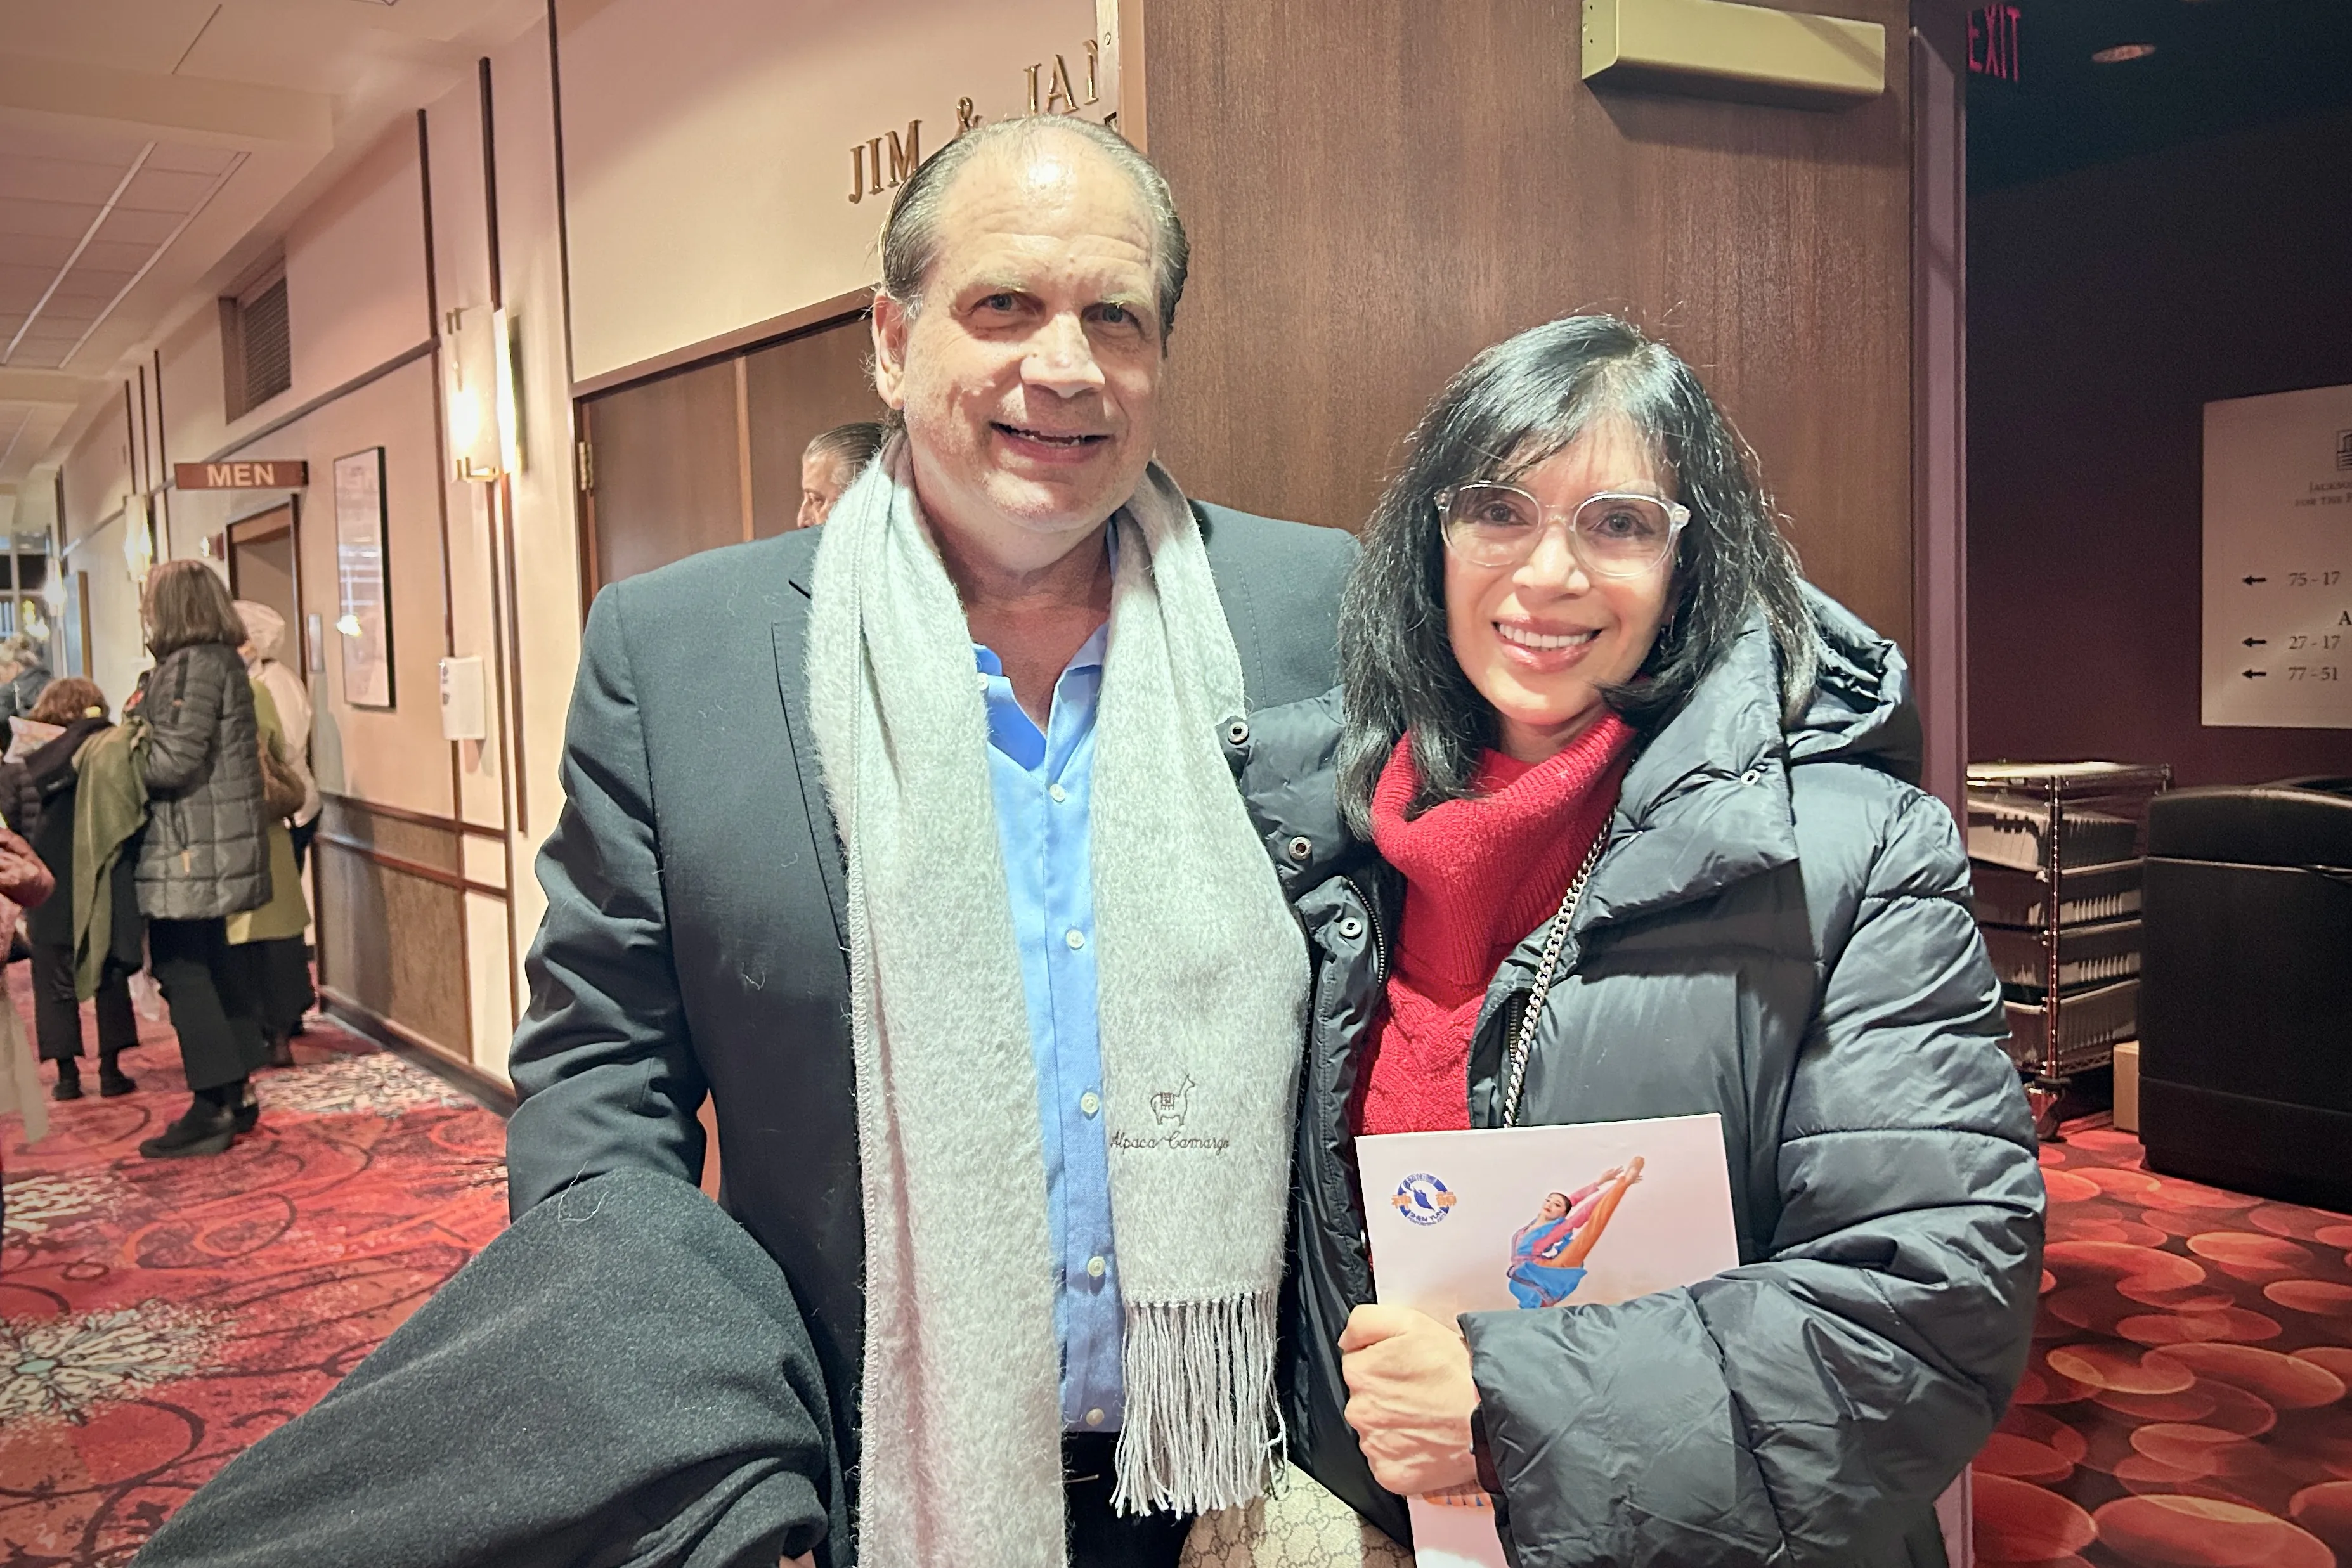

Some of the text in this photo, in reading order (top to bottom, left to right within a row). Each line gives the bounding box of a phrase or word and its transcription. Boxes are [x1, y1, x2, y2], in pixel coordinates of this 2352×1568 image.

[1968, 3, 2021, 82] EXIT
[849, 119, 923, 204] JIM
[951, 97, 983, 141] &
[207, 463, 275, 487] MEN
[1111, 1131, 1230, 1156] Alpaca Camargo
